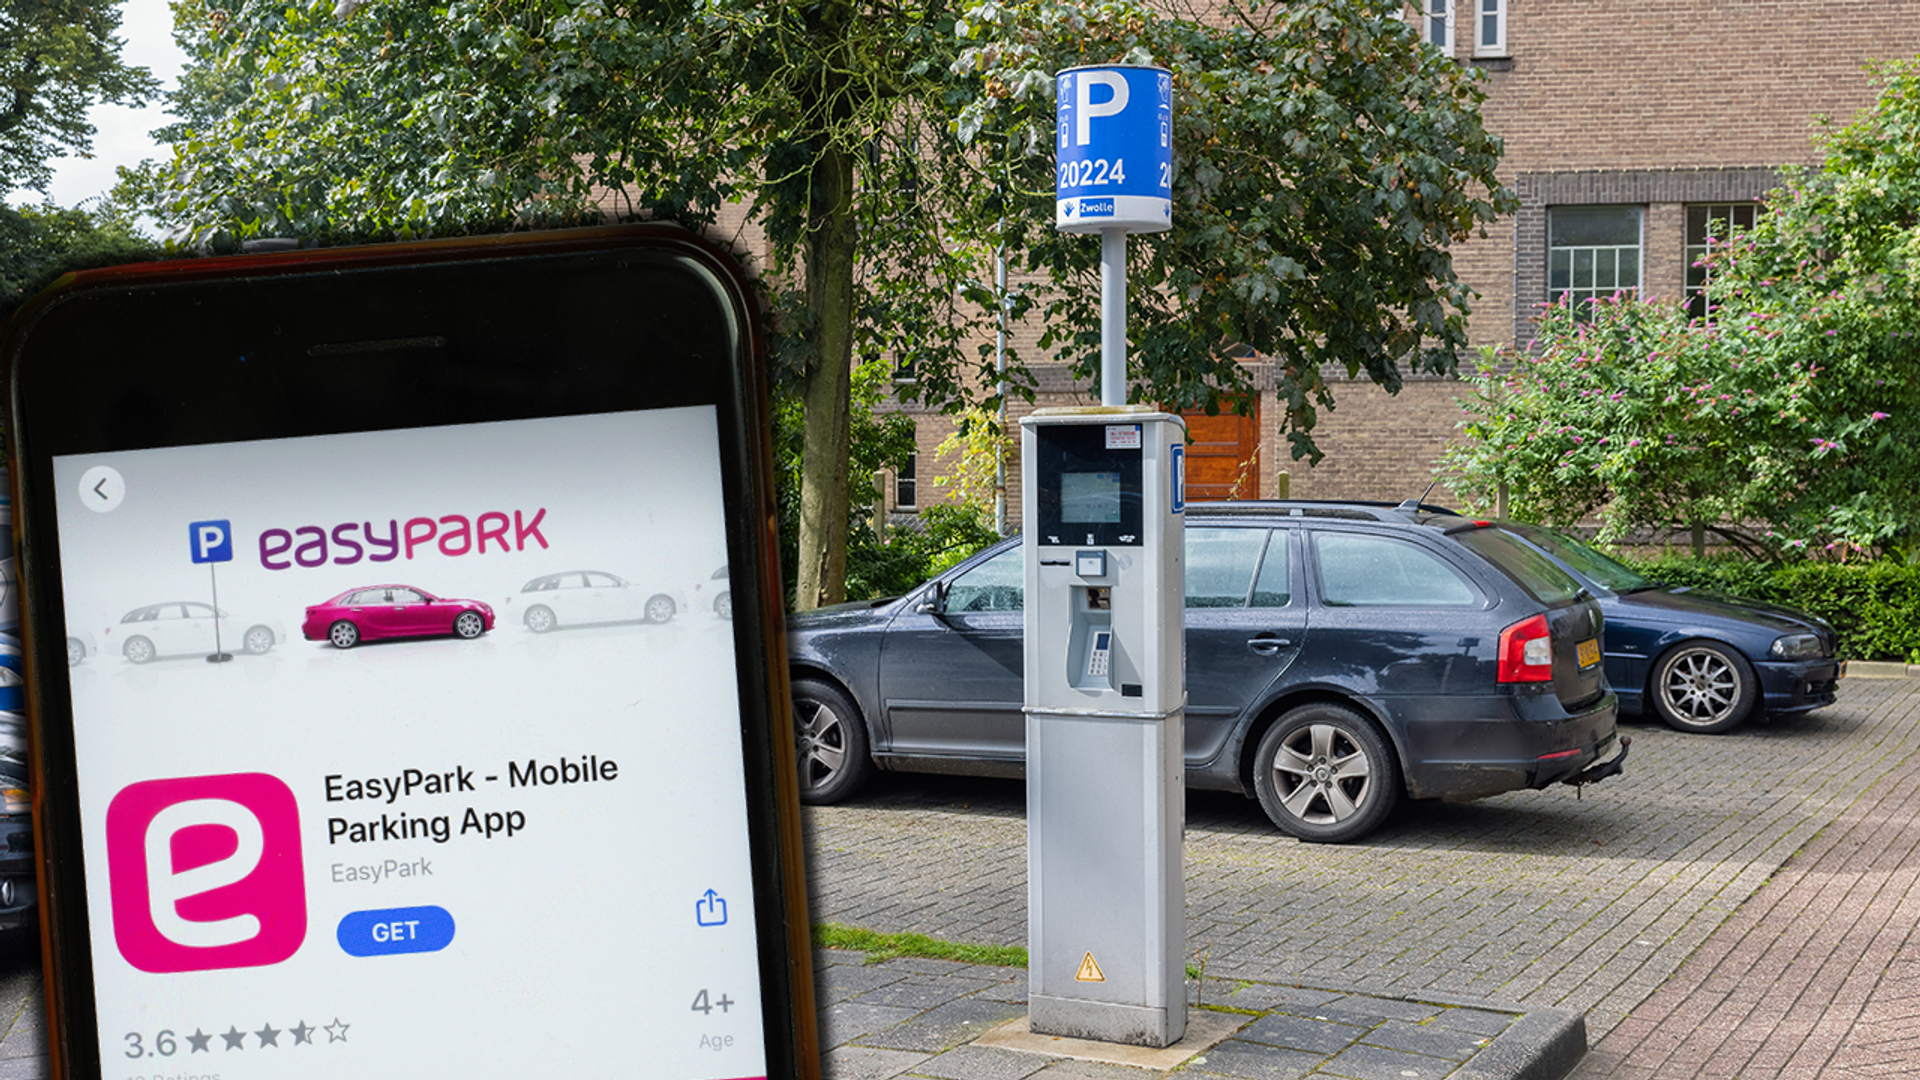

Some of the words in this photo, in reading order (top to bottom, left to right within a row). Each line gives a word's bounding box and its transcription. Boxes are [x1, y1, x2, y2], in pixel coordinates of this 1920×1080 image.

[1077, 71, 1129, 145] P
[1060, 158, 1125, 189] 20224
[1081, 202, 1114, 213] Zwolle
[198, 525, 226, 559] P
[324, 765, 475, 804] EasyPark
[508, 755, 619, 788] Mobile
[327, 811, 451, 845] Parking
[460, 807, 527, 840] App
[331, 857, 433, 884] EasyPark
[372, 920, 420, 942] GET
[691, 988, 735, 1015] 4+
[124, 1029, 178, 1059] 3.6
[699, 1033, 734, 1052] Age
